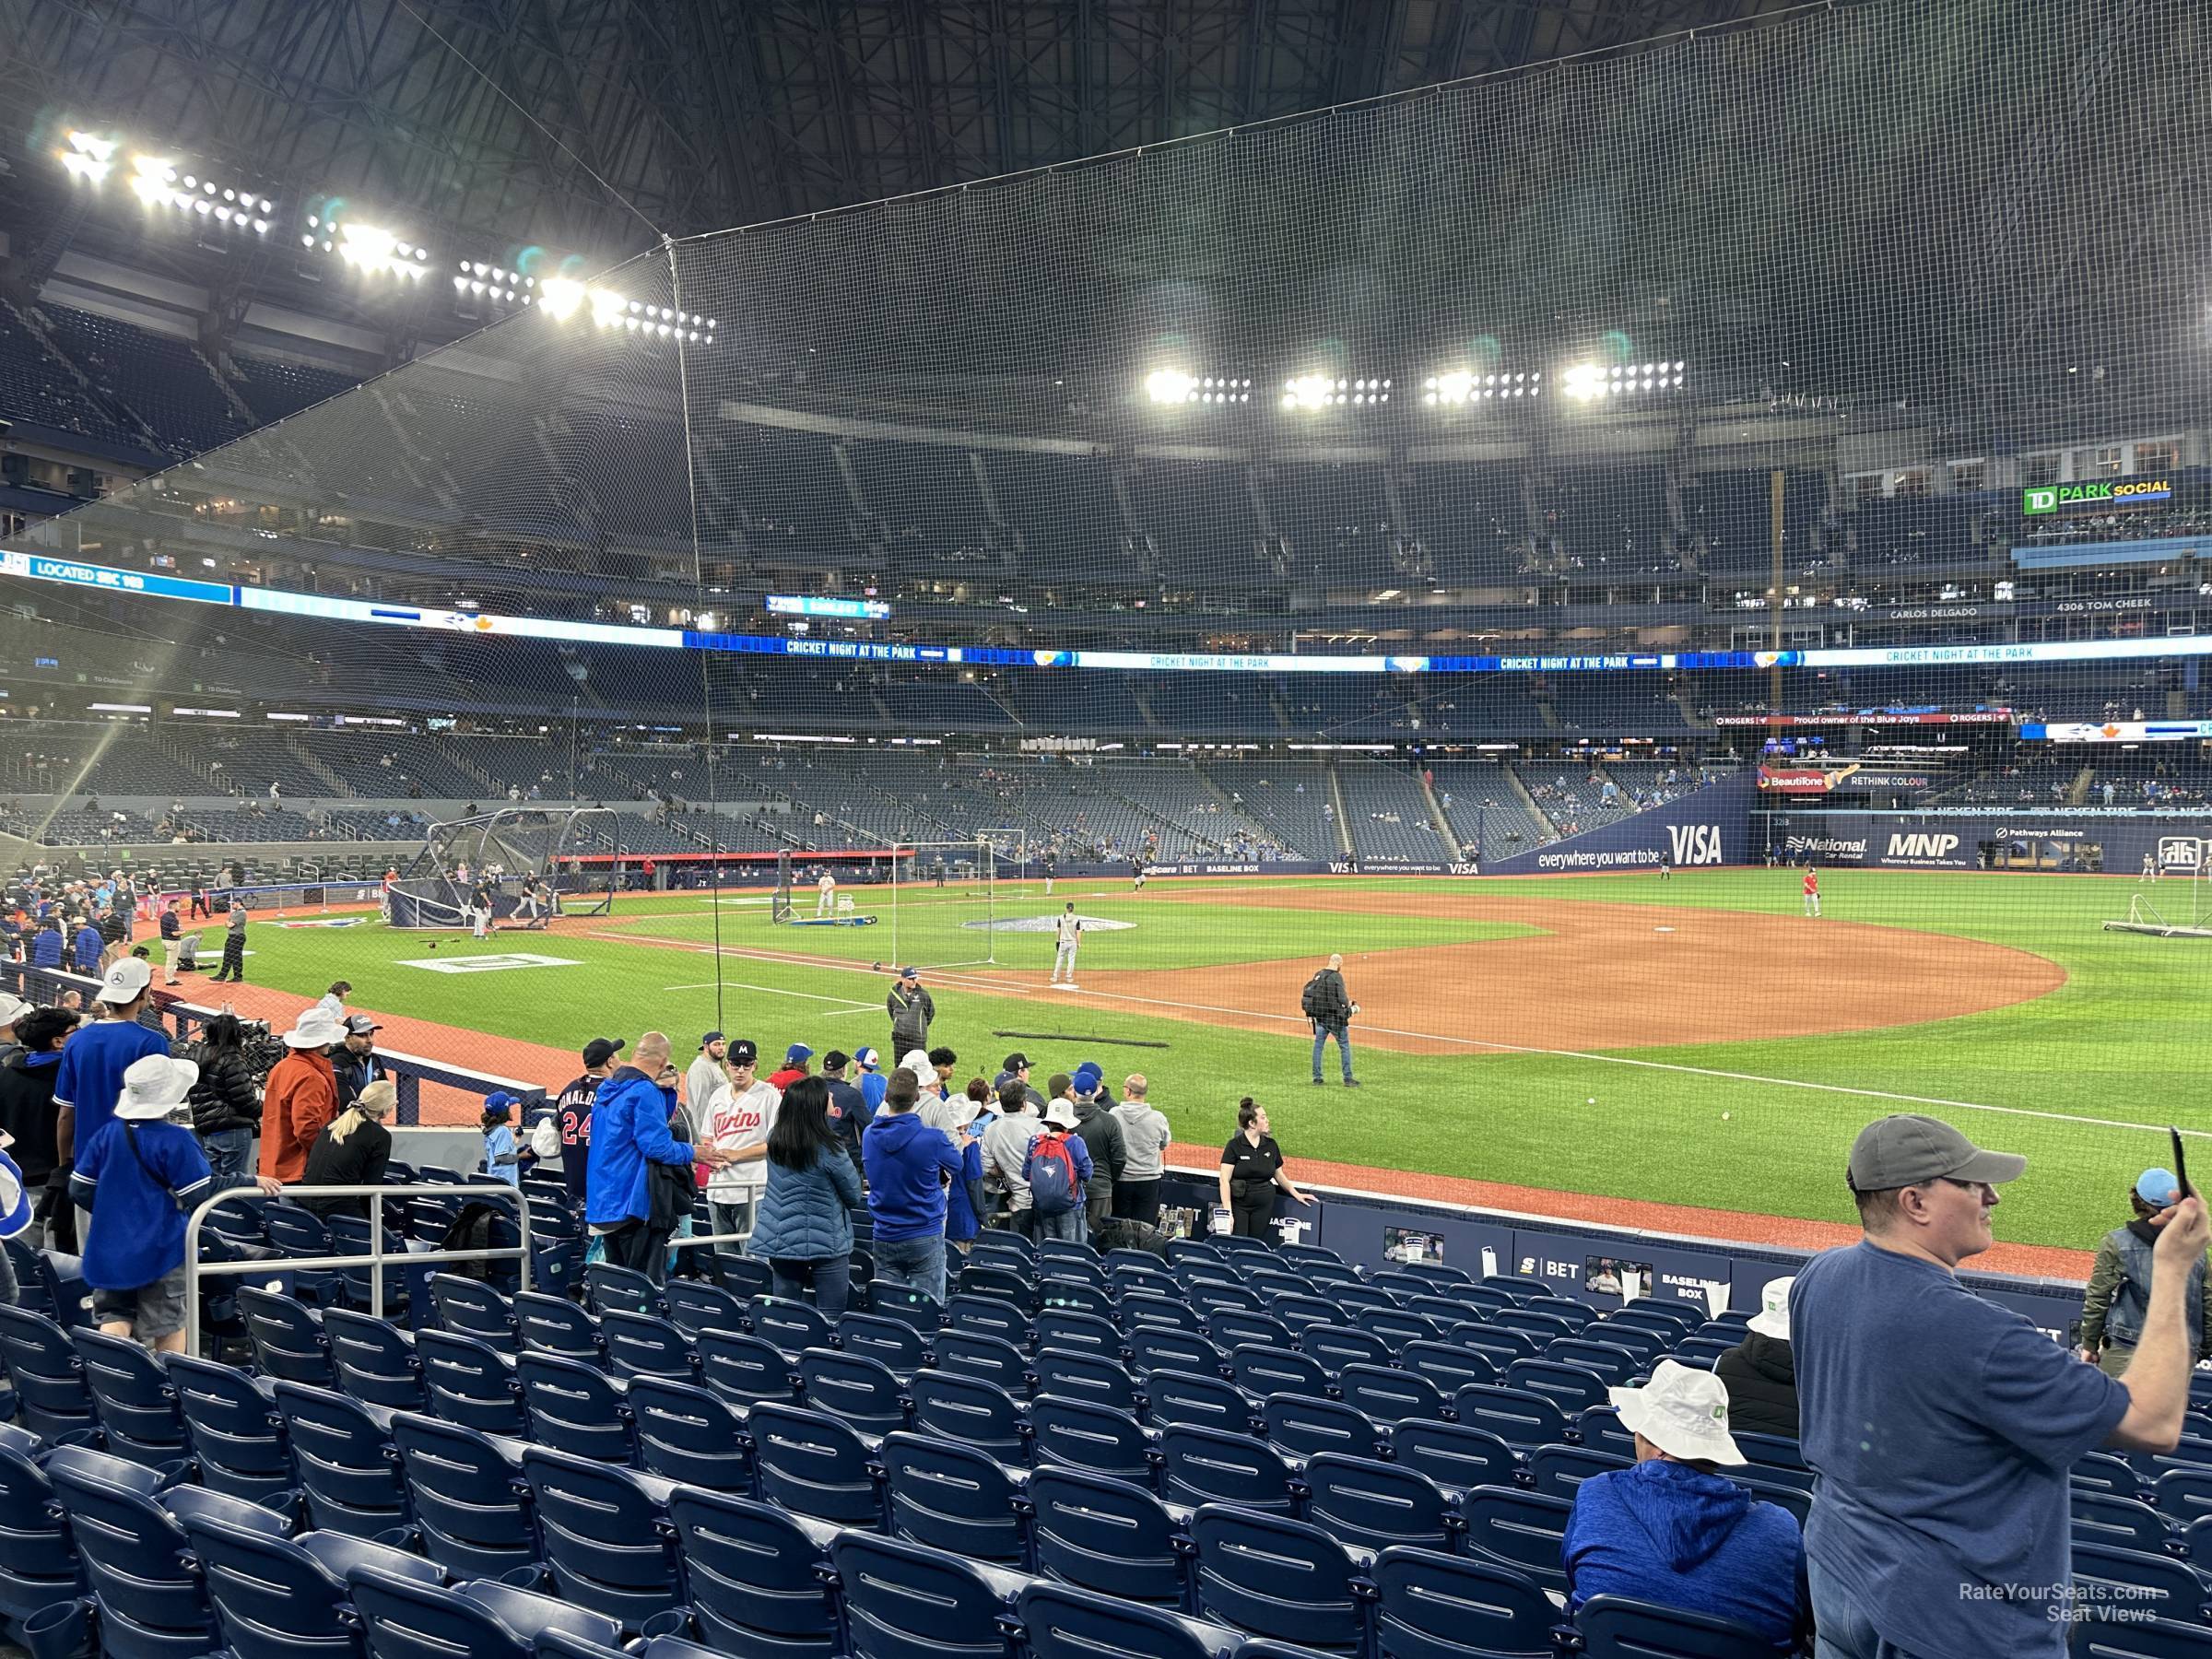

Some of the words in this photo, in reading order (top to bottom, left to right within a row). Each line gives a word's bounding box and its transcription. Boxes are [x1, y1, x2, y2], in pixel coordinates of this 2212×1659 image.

[2028, 491, 2055, 510] TD
[2059, 482, 2112, 501] PARK
[2113, 480, 2171, 497] SOCIAL
[38, 561, 94, 582] LOCATED
[2057, 601, 2085, 612] 4306
[2087, 600, 2112, 610] TOM
[2115, 598, 2151, 609] CHEEK
[1890, 609, 1927, 619] CARLOS
[1931, 607, 1977, 618] DELGADO
[786, 641, 826, 654] CRICKET
[830, 642, 857, 656] NIGHT
[859, 644, 871, 657] AT
[872, 645, 889, 658] THE
[891, 646, 915, 659] PARK
[1887, 651, 1928, 662] CRICKET
[1933, 650, 1964, 660] NIGHT
[1967, 649, 1978, 659] AT
[1983, 649, 2001, 659] THE
[2006, 648, 2033, 657] PARK
[1151, 657, 1185, 666] CRICKET
[1189, 657, 1214, 666] NIGHT
[1217, 657, 1226, 667] AT
[1230, 658, 1244, 667] THE
[1248, 658, 1269, 667] PARK
[1500, 658, 1538, 669] CRICKET
[1541, 657, 1568, 669] NIGHT
[1570, 657, 1581, 668] AT
[1583, 657, 1601, 668] THE
[1603, 656, 1628, 668] PARK
[1725, 717, 1755, 725] ROGERS
[1794, 716, 1821, 724] Proud
[1822, 717, 1847, 725] owner
[1850, 716, 1859, 724] of
[1861, 715, 1876, 724] the
[1877, 715, 1897, 724] Blue
[1898, 715, 1920, 725] Jays
[1959, 714, 1992, 723] ROGERS
[1852, 777, 1889, 786] RETHINK
[1891, 777, 1927, 786] COLOUR
[2009, 830, 2048, 838] Pathways
[2050, 830, 2083, 838] Alliance
[1665, 825, 1723, 865] VISA
[1888, 833, 1959, 857] MNP
[1538, 850, 1595, 870] everywhere
[1596, 852, 1614, 868] you
[1615, 850, 1637, 865] want
[1638, 850, 1648, 864] to
[1648, 848, 1659, 864] be
[1182, 865, 1198, 873] BET
[1244, 865, 1259, 873] BOX
[1364, 864, 1397, 872] everywhere
[1447, 863, 1478, 874] VISA
[713, 1107, 760, 1139] Twins
[1521, 1257, 1535, 1270] S
[1547, 1260, 1579, 1279] BET
[1677, 1288, 1703, 1300] BOX
